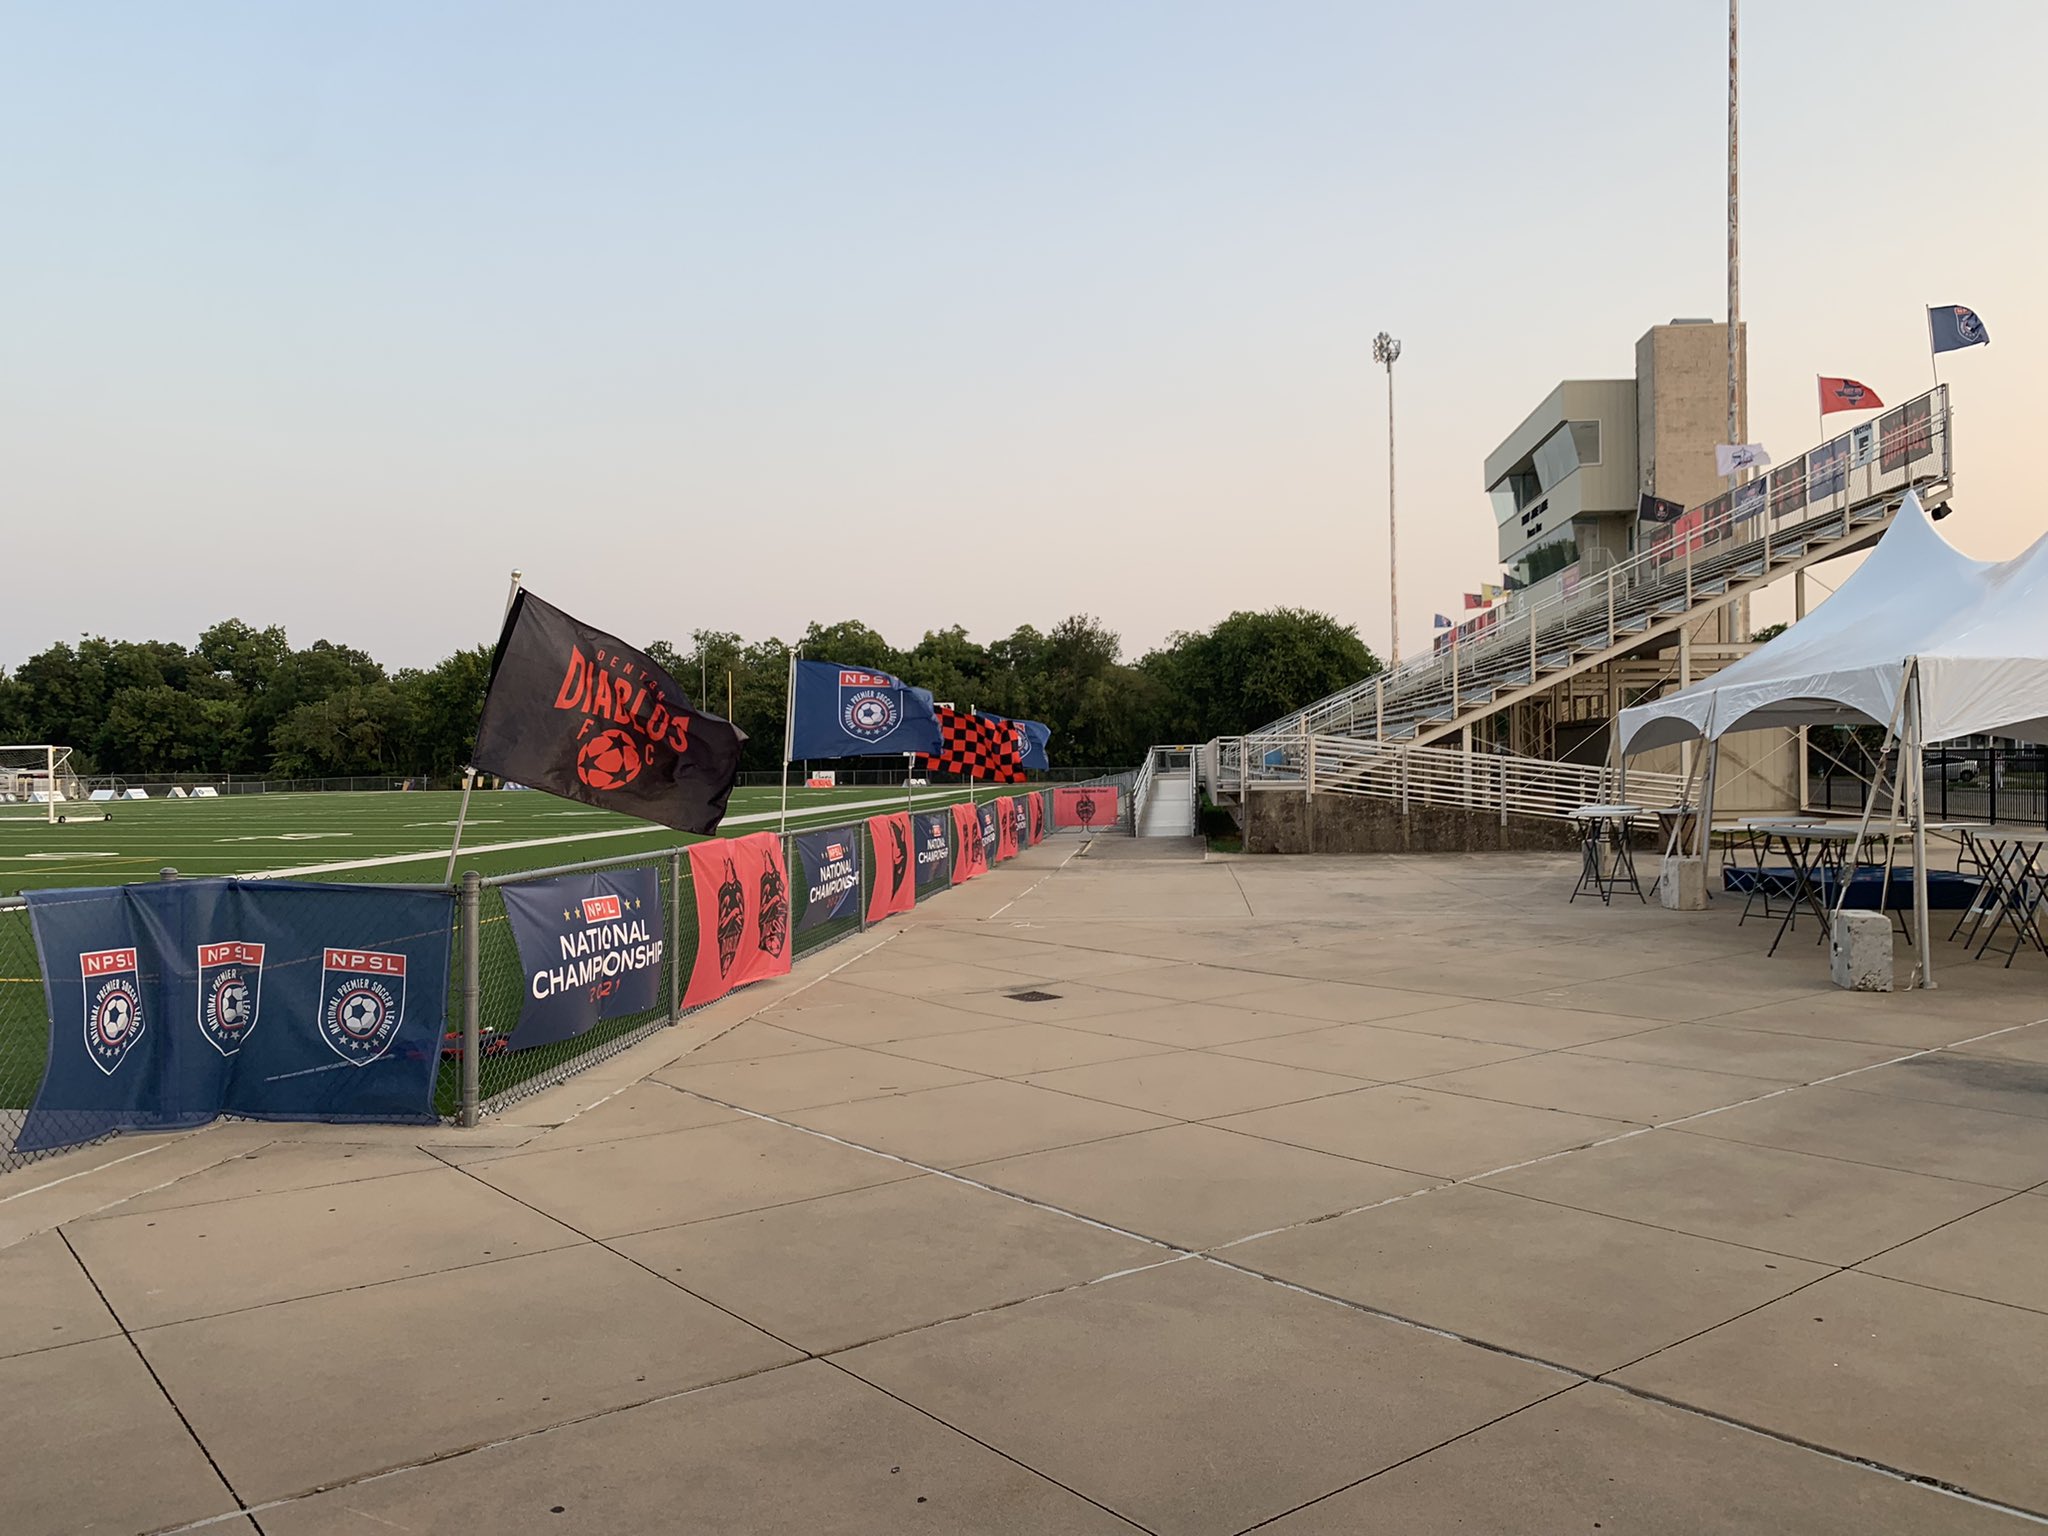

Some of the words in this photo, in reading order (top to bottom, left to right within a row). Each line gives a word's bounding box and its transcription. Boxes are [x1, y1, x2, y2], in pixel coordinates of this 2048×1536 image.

[596, 649, 666, 702] DENTON
[845, 674, 890, 685] NPS
[553, 644, 690, 753] DIABLOS
[576, 718, 596, 741] F
[644, 743, 655, 766] C
[820, 858, 852, 882] NATIONAL
[559, 919, 650, 960] NATIONAL
[87, 952, 133, 971] NPSL
[331, 953, 398, 971] NPSL
[532, 939, 663, 1000] CHAMPIONSHIP
[206, 993, 217, 1032] NATIONAL
[212, 968, 237, 991] PREMIER
[337, 978, 370, 997] PREMIER
[371, 981, 393, 1008] SOCCER
[89, 1005, 101, 1046] NATIONAL
[96, 978, 120, 1003] PREMIER
[121, 980, 138, 1005] SOCCER
[327, 996, 341, 1035] NATIONAL
[377, 1010, 395, 1040] LEAGUE
